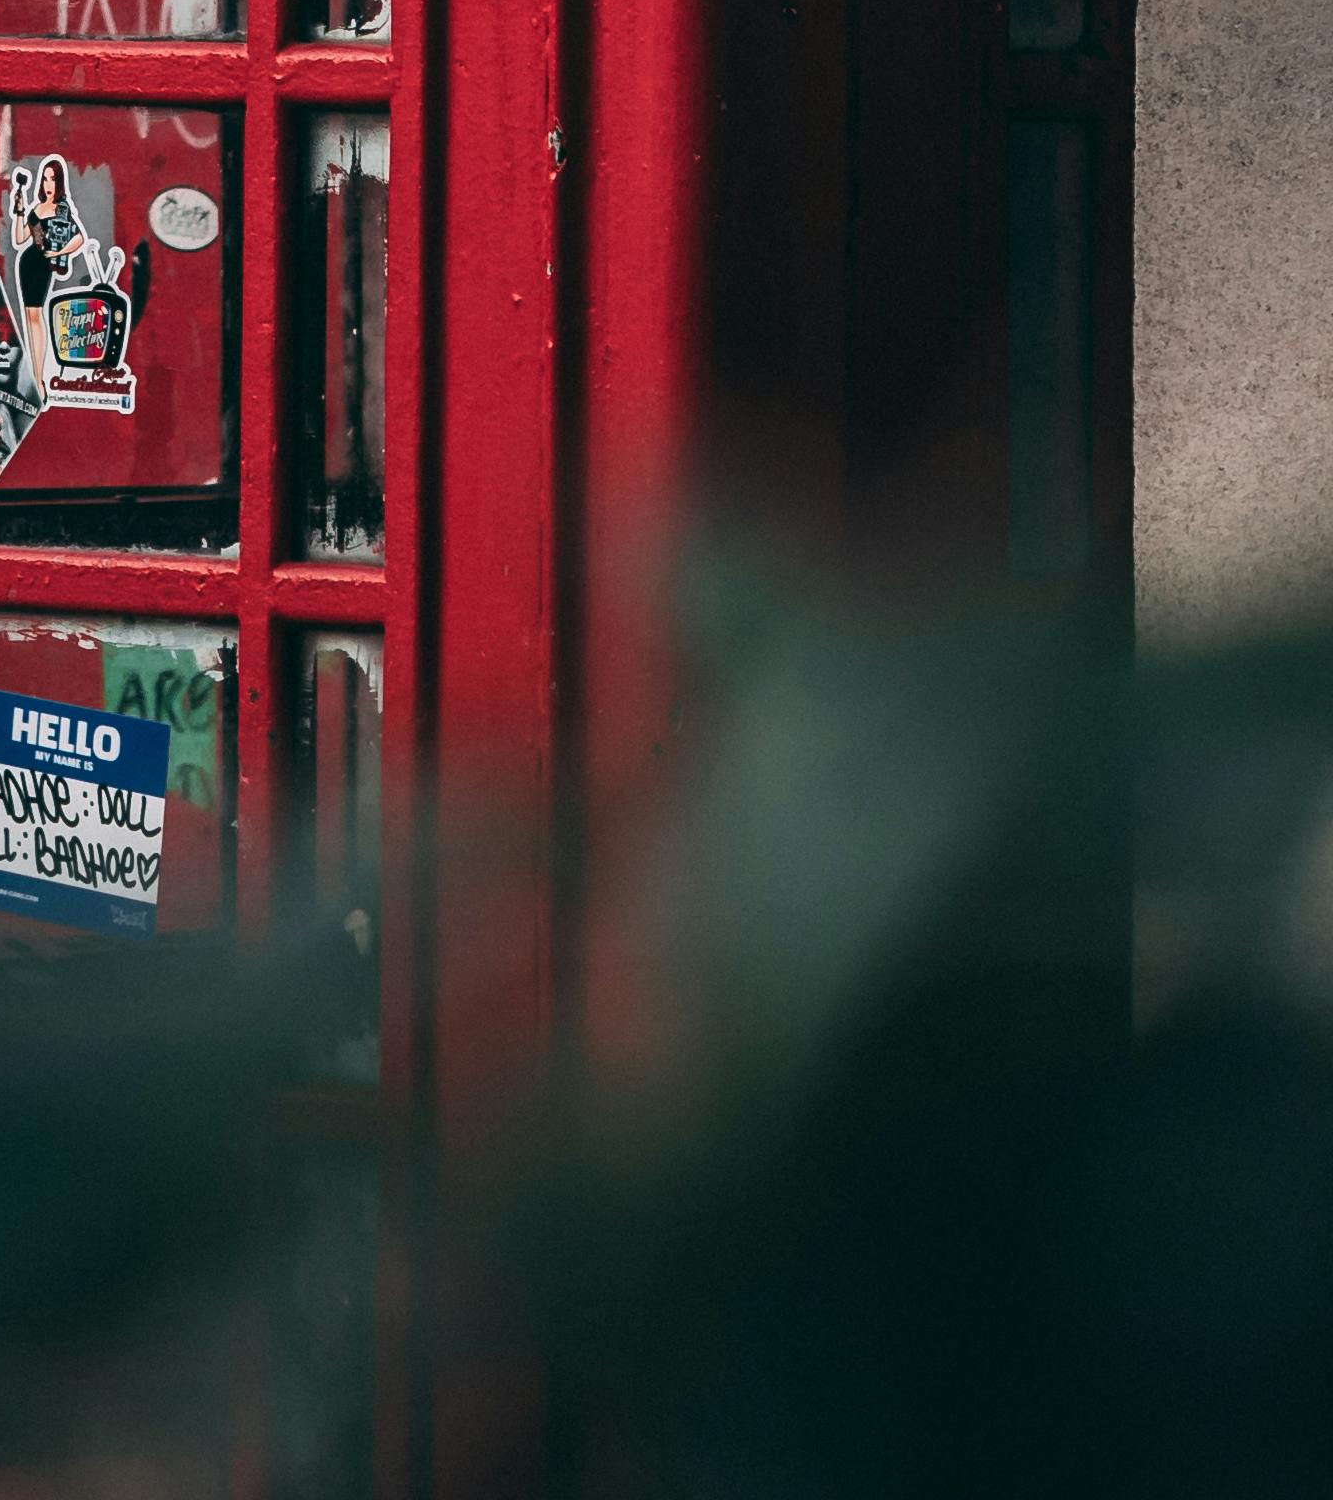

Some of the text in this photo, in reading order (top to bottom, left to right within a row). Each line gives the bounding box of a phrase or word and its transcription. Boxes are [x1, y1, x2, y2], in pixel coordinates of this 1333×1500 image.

[59, 307, 96, 331] Happy
[11, 706, 121, 762] HELLO
[35, 750, 94, 772] MY NAME IS
